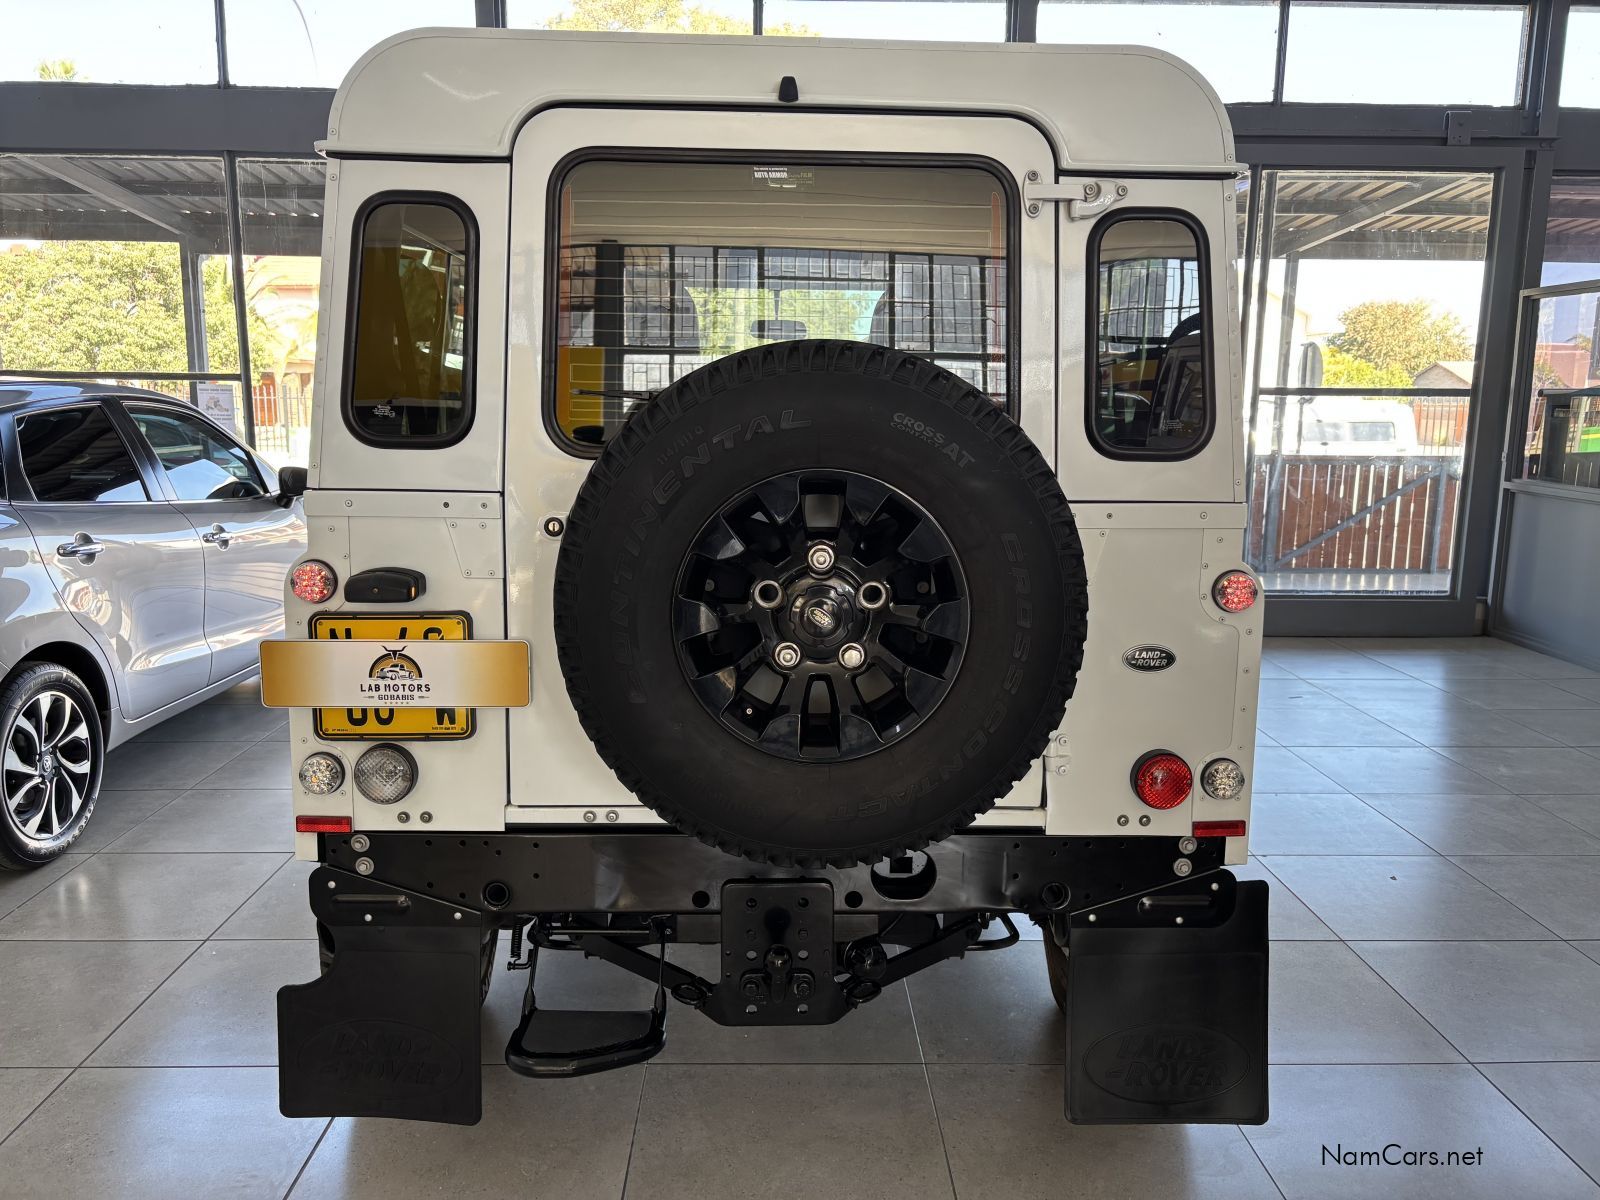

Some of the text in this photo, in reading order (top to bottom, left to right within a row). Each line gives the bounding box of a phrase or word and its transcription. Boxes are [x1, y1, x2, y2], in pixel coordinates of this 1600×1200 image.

[890, 422, 941, 448] CONTACT
[893, 412, 976, 468] CROSS AT
[360, 683, 431, 692] LAB MOTORS
